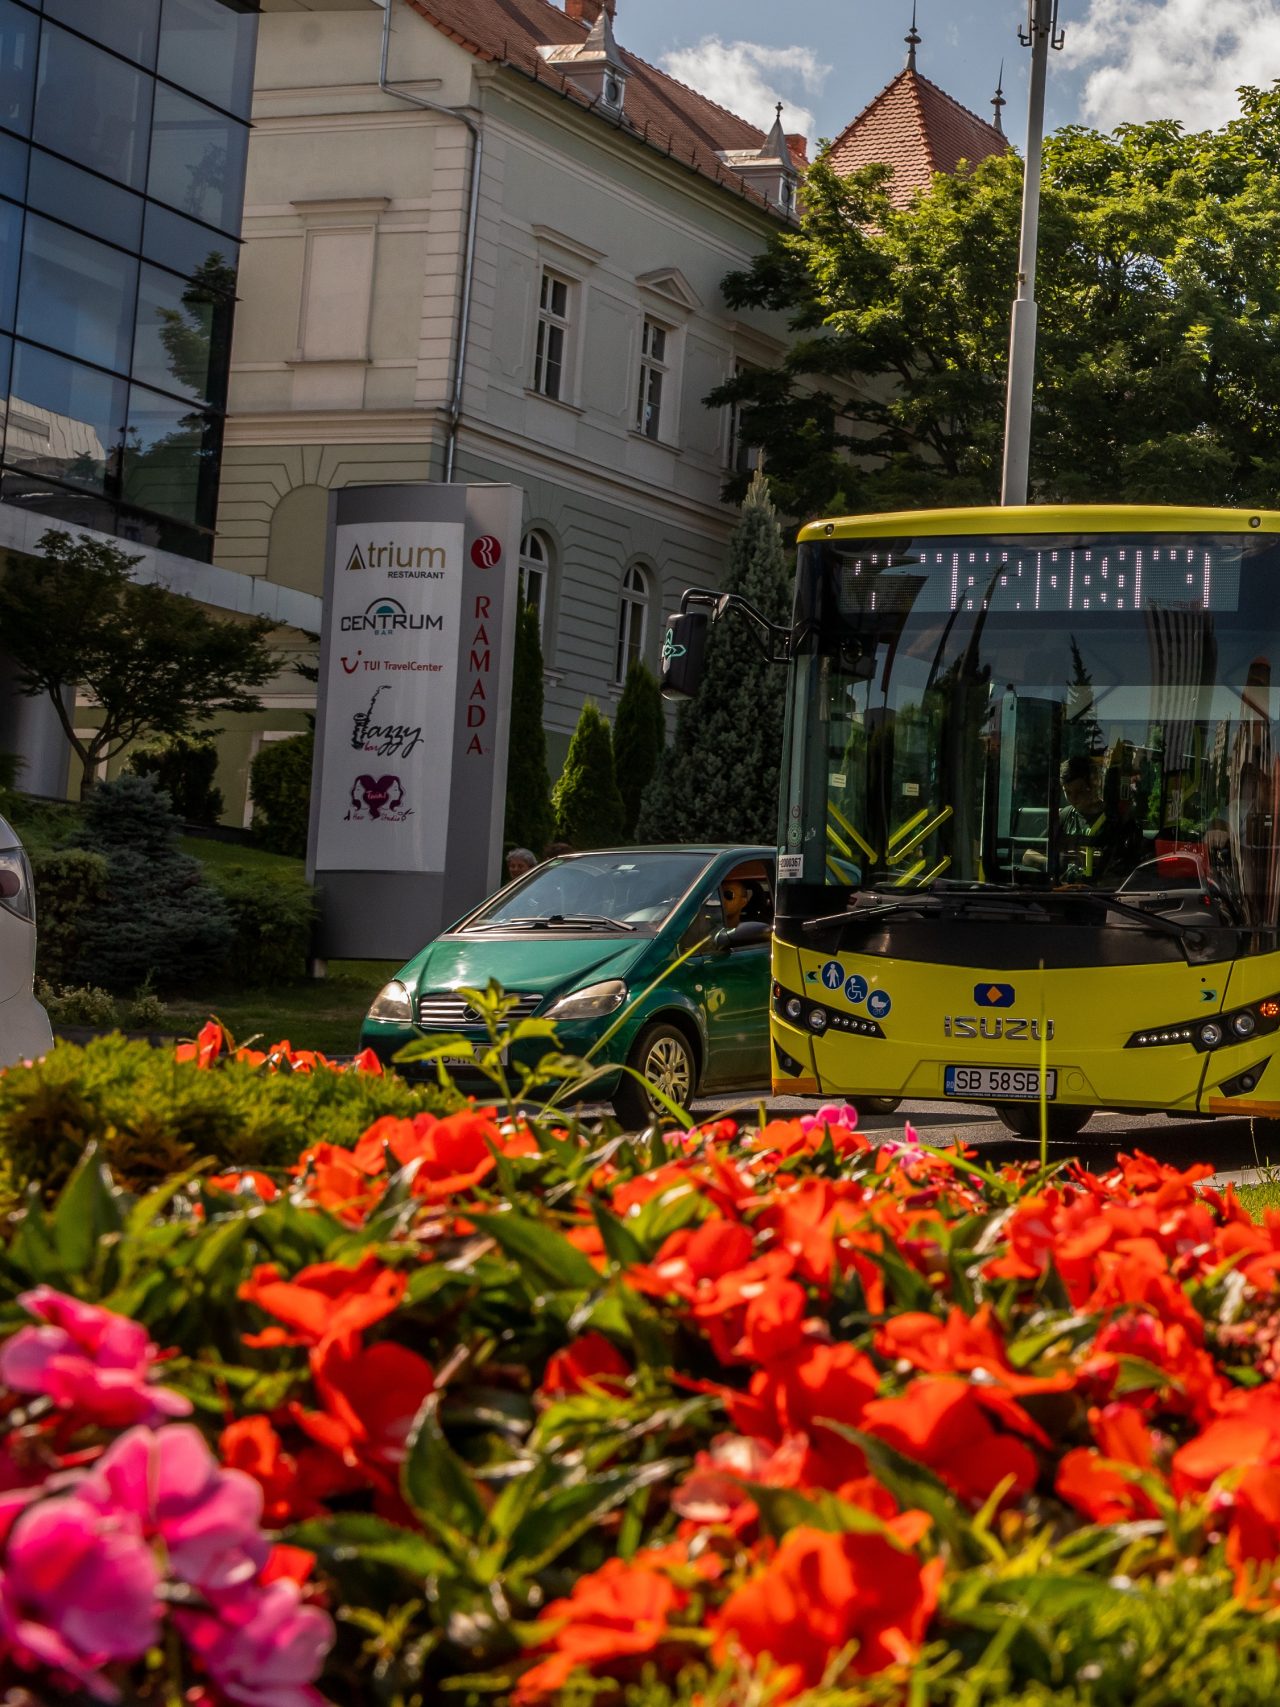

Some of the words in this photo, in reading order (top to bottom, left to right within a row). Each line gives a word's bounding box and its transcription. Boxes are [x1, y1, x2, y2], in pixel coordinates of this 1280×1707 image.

[388, 571, 444, 579] RESTAURANT
[341, 614, 443, 631] CENTRUM
[363, 661, 380, 671] TUI
[384, 661, 443, 672] TravelCenter
[466, 596, 490, 755] RAMADA
[944, 1015, 1054, 1041] ISUZU
[956, 1070, 982, 1090] SB
